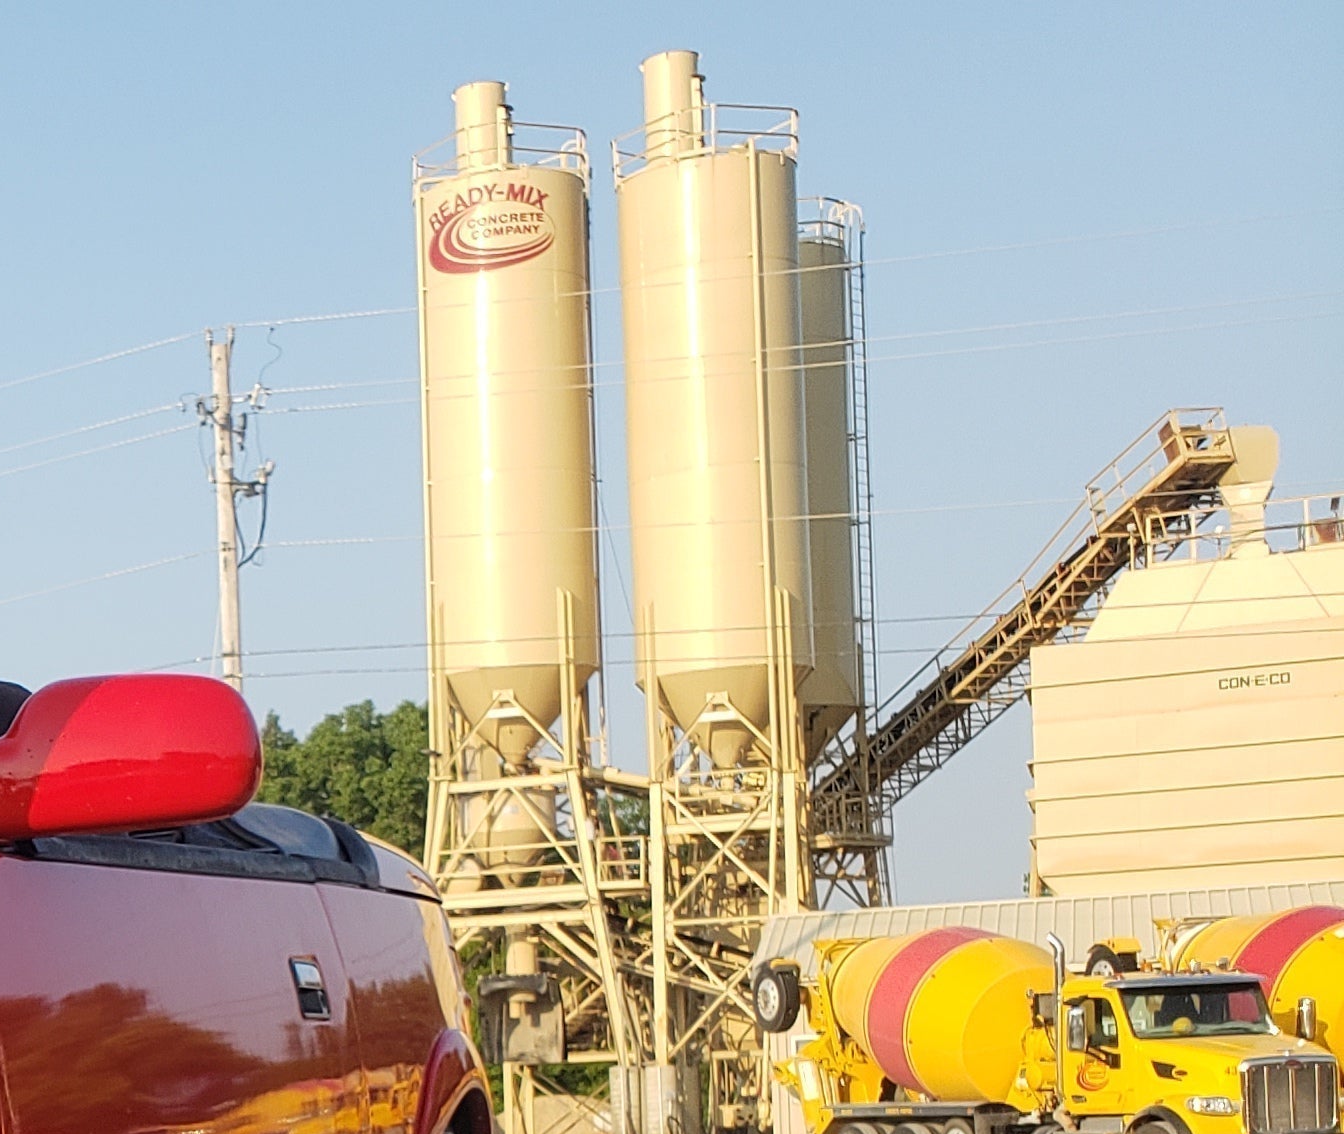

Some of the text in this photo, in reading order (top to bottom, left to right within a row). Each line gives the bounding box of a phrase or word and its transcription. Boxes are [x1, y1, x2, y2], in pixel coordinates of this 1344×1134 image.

[429, 183, 549, 233] READY-MIX
[467, 212, 545, 229] CONCRETE
[472, 225, 540, 240] COMPANY
